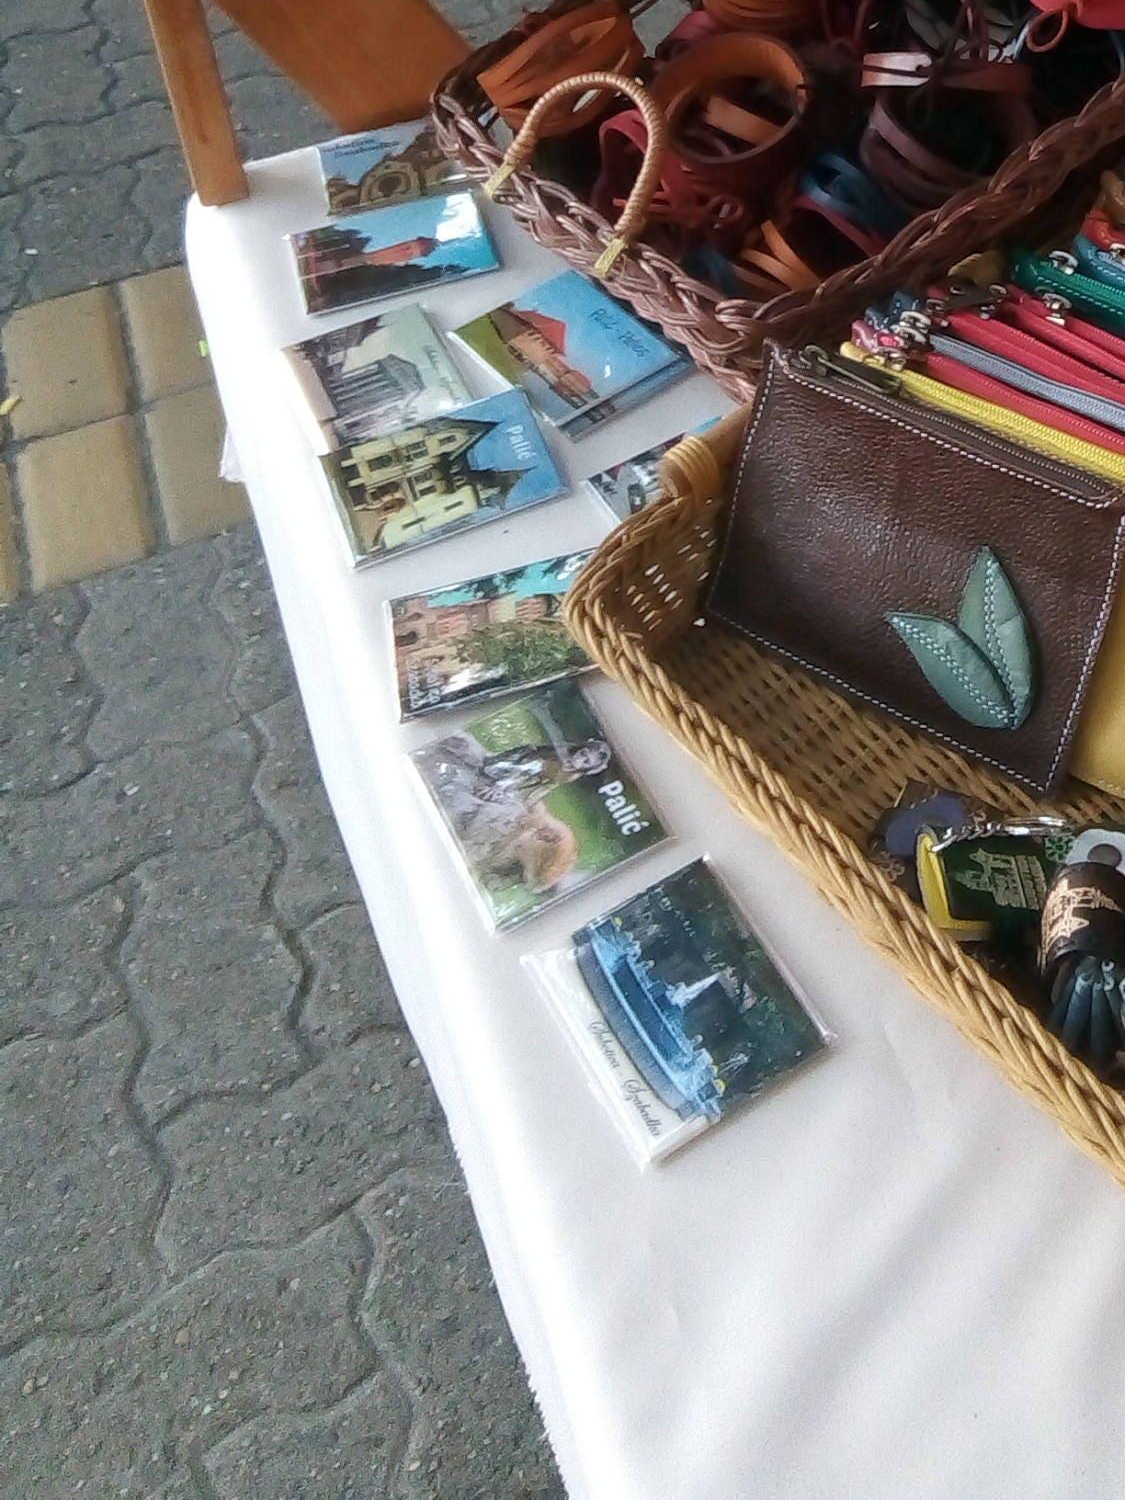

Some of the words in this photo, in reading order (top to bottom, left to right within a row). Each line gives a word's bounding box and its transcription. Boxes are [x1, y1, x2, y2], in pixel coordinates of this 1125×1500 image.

[506, 424, 538, 461] Palić
[598, 780, 650, 835] Palić
[622, 1079, 663, 1137] Szabadka
